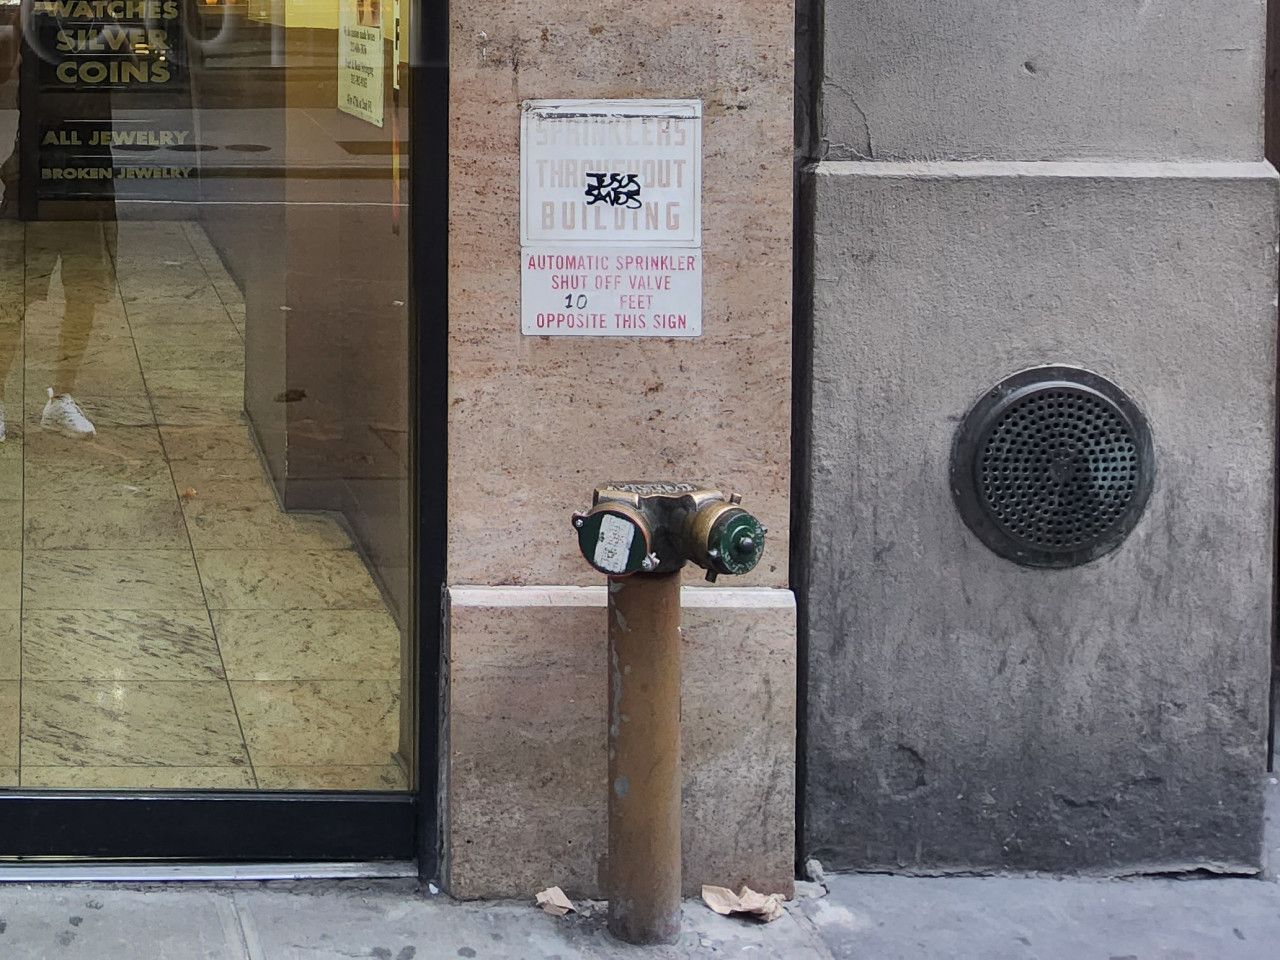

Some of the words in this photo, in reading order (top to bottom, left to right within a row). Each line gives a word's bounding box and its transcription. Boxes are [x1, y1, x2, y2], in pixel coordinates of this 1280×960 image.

[56, 27, 171, 51] SILVER
[56, 61, 171, 84] COINS
[41, 130, 82, 146] ALL
[88, 130, 190, 146] JEWELRY
[41, 167, 113, 180] BROKEN
[116, 167, 192, 180] JEWELRY
[527, 254, 610, 271] AUTOMATIC
[615, 255, 696, 271] SPRINKLER
[551, 274, 589, 290] SHUT
[594, 275, 622, 290] OFF
[629, 275, 672, 290] VALVE
[564, 293, 588, 310] 10
[620, 294, 655, 310] FEET
[536, 313, 607, 329] OPPOSITE
[614, 313, 646, 329] THIS
[652, 313, 687, 330] SIGN
